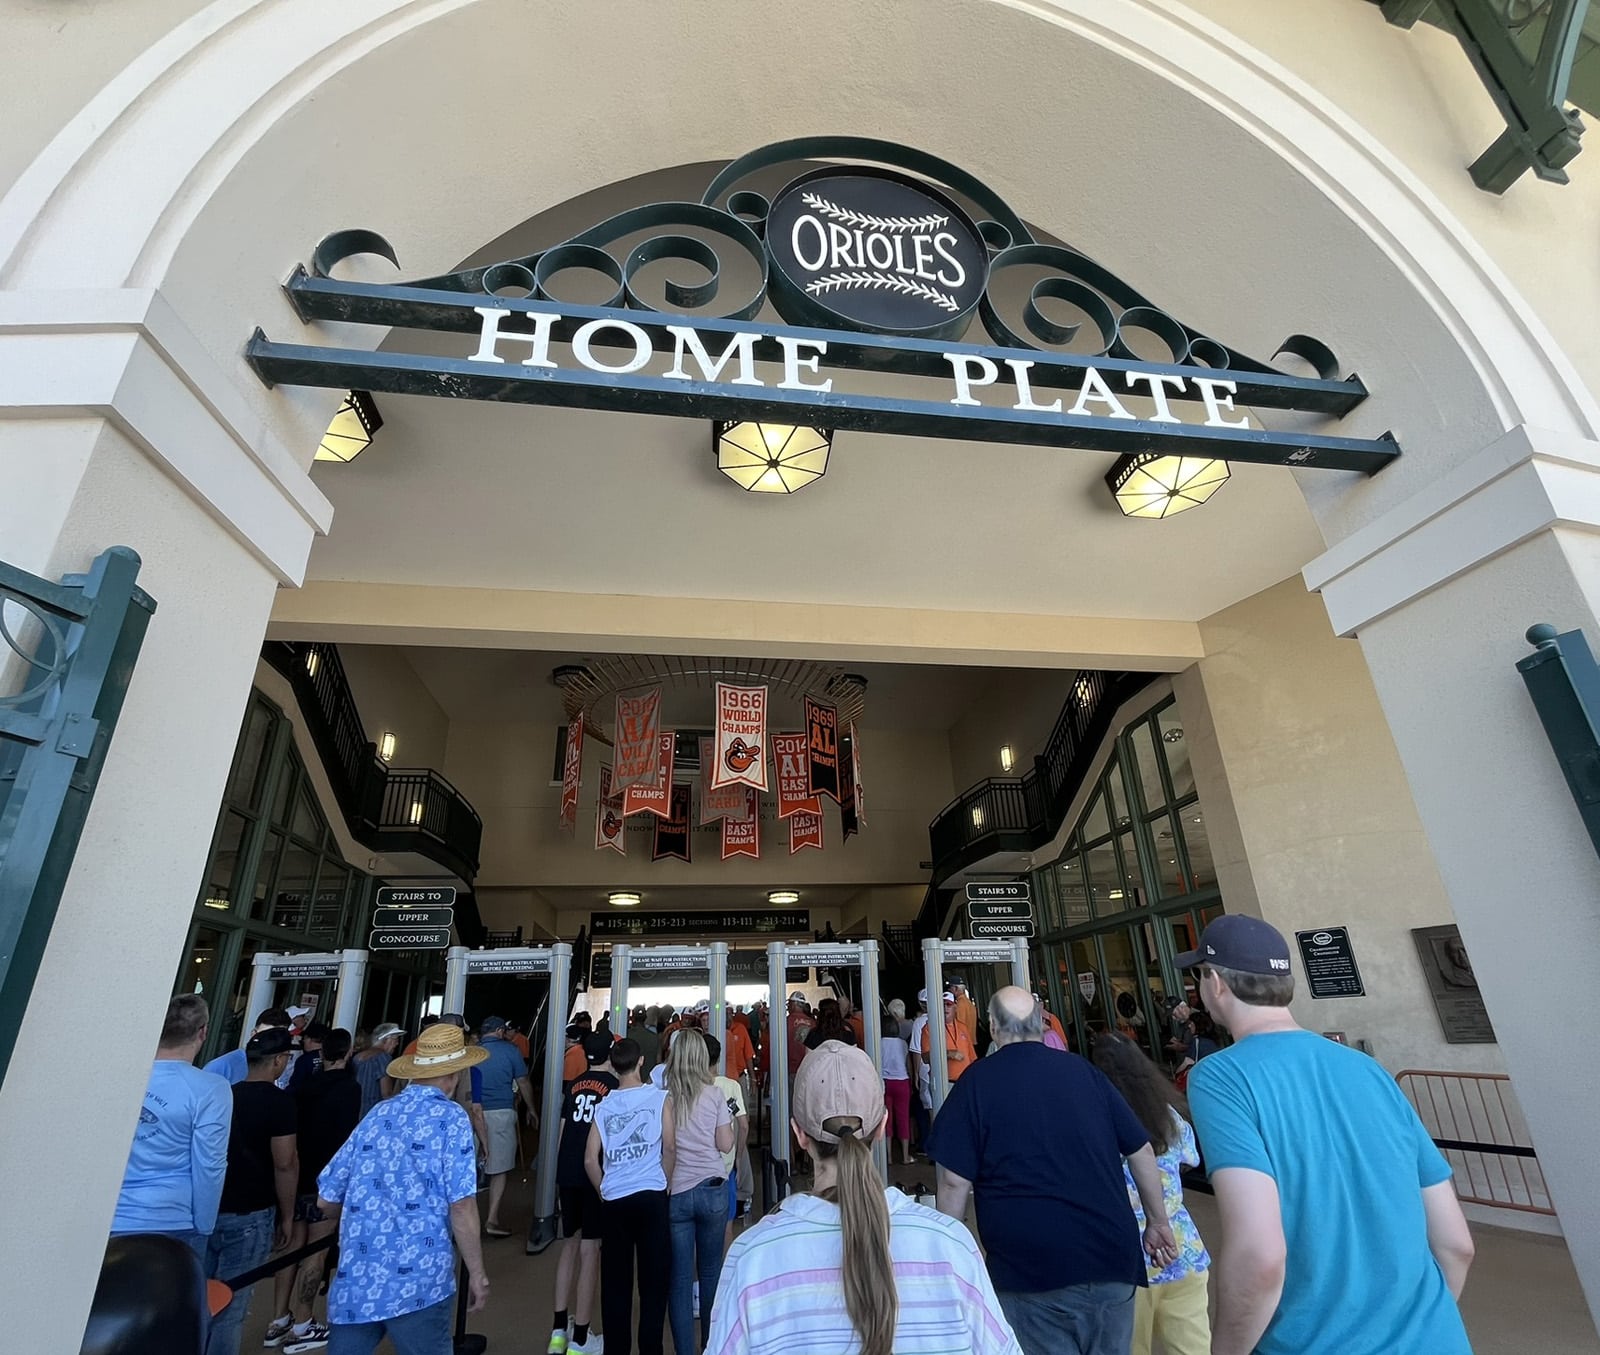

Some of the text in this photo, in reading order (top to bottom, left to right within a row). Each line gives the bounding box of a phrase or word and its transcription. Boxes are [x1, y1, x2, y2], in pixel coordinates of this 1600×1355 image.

[791, 214, 967, 288] ORIOLES
[467, 307, 1250, 430] HOME PLATE
[722, 690, 762, 709] 1966
[722, 708, 761, 723] WORLD
[808, 704, 834, 728] 1969
[722, 722, 761, 735] CHAMPS
[810, 724, 835, 755] AL
[619, 758, 653, 777] CARD
[782, 778, 808, 791] EAS
[632, 790, 665, 799] CHAMPS
[793, 815, 817, 828] EAST
[727, 824, 755, 836] EAST
[727, 836, 755, 844] CHAMPS
[392, 892, 442, 901] STAIRS TO
[987, 906, 1013, 914] UPPER
[608, 919, 641, 928] 115-113
[651, 918, 686, 927] 215-213
[723, 917, 753, 926] 113-111
[379, 935, 441, 943] CONCOURSE
[573, 1094, 597, 1123] 35
